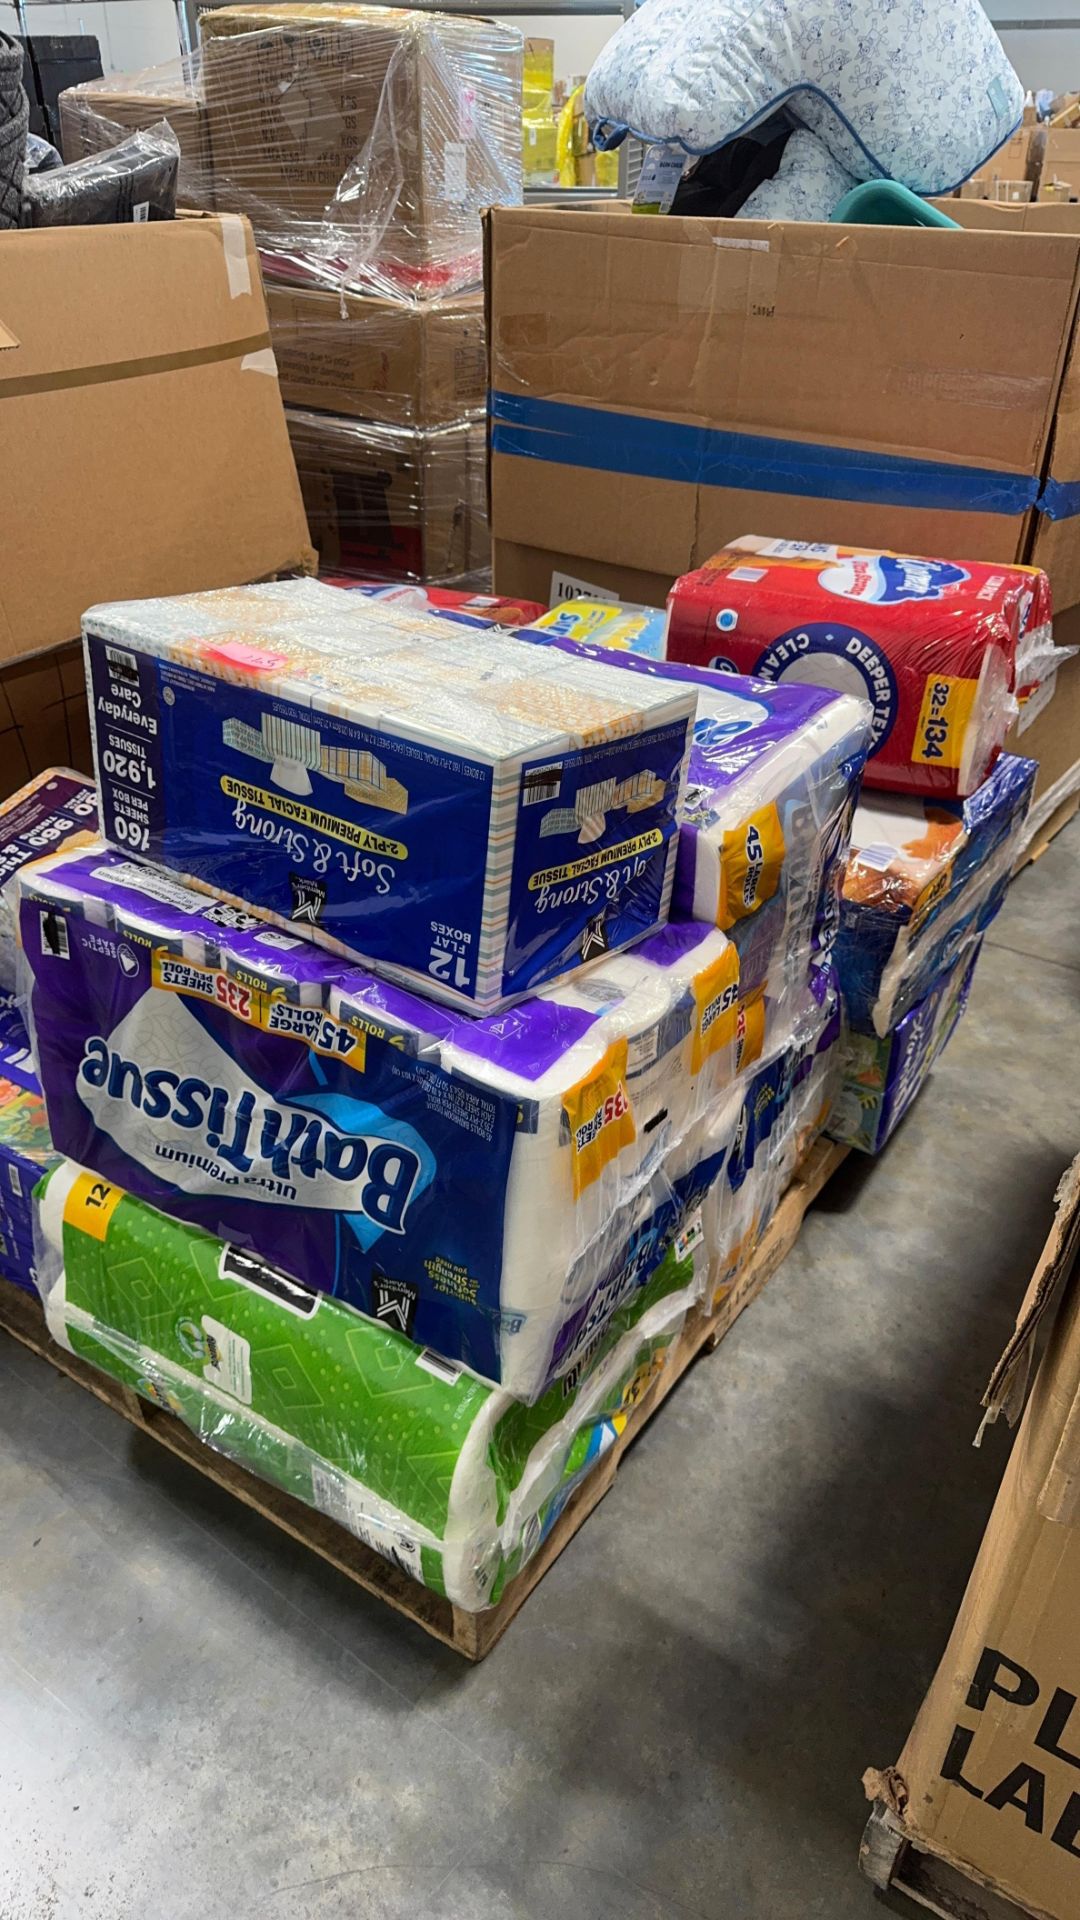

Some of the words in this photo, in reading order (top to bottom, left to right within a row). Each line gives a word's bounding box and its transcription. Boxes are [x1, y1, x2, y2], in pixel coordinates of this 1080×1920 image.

[845, 636, 891, 702] DEEPER
[111, 684, 142, 708] Care
[98, 698, 158, 735] Everyday
[109, 734, 147, 758] TISSUES
[102, 751, 156, 789] 1,920
[112, 788, 130, 804] BOX
[130, 794, 149, 811] PER
[225, 781, 266, 805] TISSUE
[114, 803, 149, 825] SHEETS
[266, 794, 308, 821] FACIAL
[28, 819, 74, 846] 960
[114, 816, 151, 852] 160
[231, 800, 309, 863] Strong
[309, 805, 362, 843] PREMIUM
[363, 833, 399, 856] 2-PLY
[600, 843, 637, 864] PREMIUM
[746, 825, 763, 861] 45
[312, 838, 332, 873] &
[335, 850, 396, 894] Soft
[533, 867, 568, 887] TISSUE
[534, 876, 603, 914] Strong
[604, 869, 620, 901] &
[89, 934, 116, 949] SAFE
[430, 920, 472, 944] BOXES
[433, 935, 466, 953] FLAT
[81, 938, 117, 959] SEPTIC
[161, 961, 192, 977] ROLL
[193, 967, 213, 983] PER
[427, 948, 471, 988] 12
[163, 970, 214, 995] SHEETS
[236, 970, 267, 991] ROLLS
[215, 974, 251, 1018] 235
[270, 1018, 319, 1042] LARGE
[319, 1020, 357, 1055] 45
[351, 1015, 386, 1039] ROLLS
[154, 1143, 241, 1185] Premium
[85, 1183, 111, 1207] 12
[243, 1176, 297, 1200] Ultra
